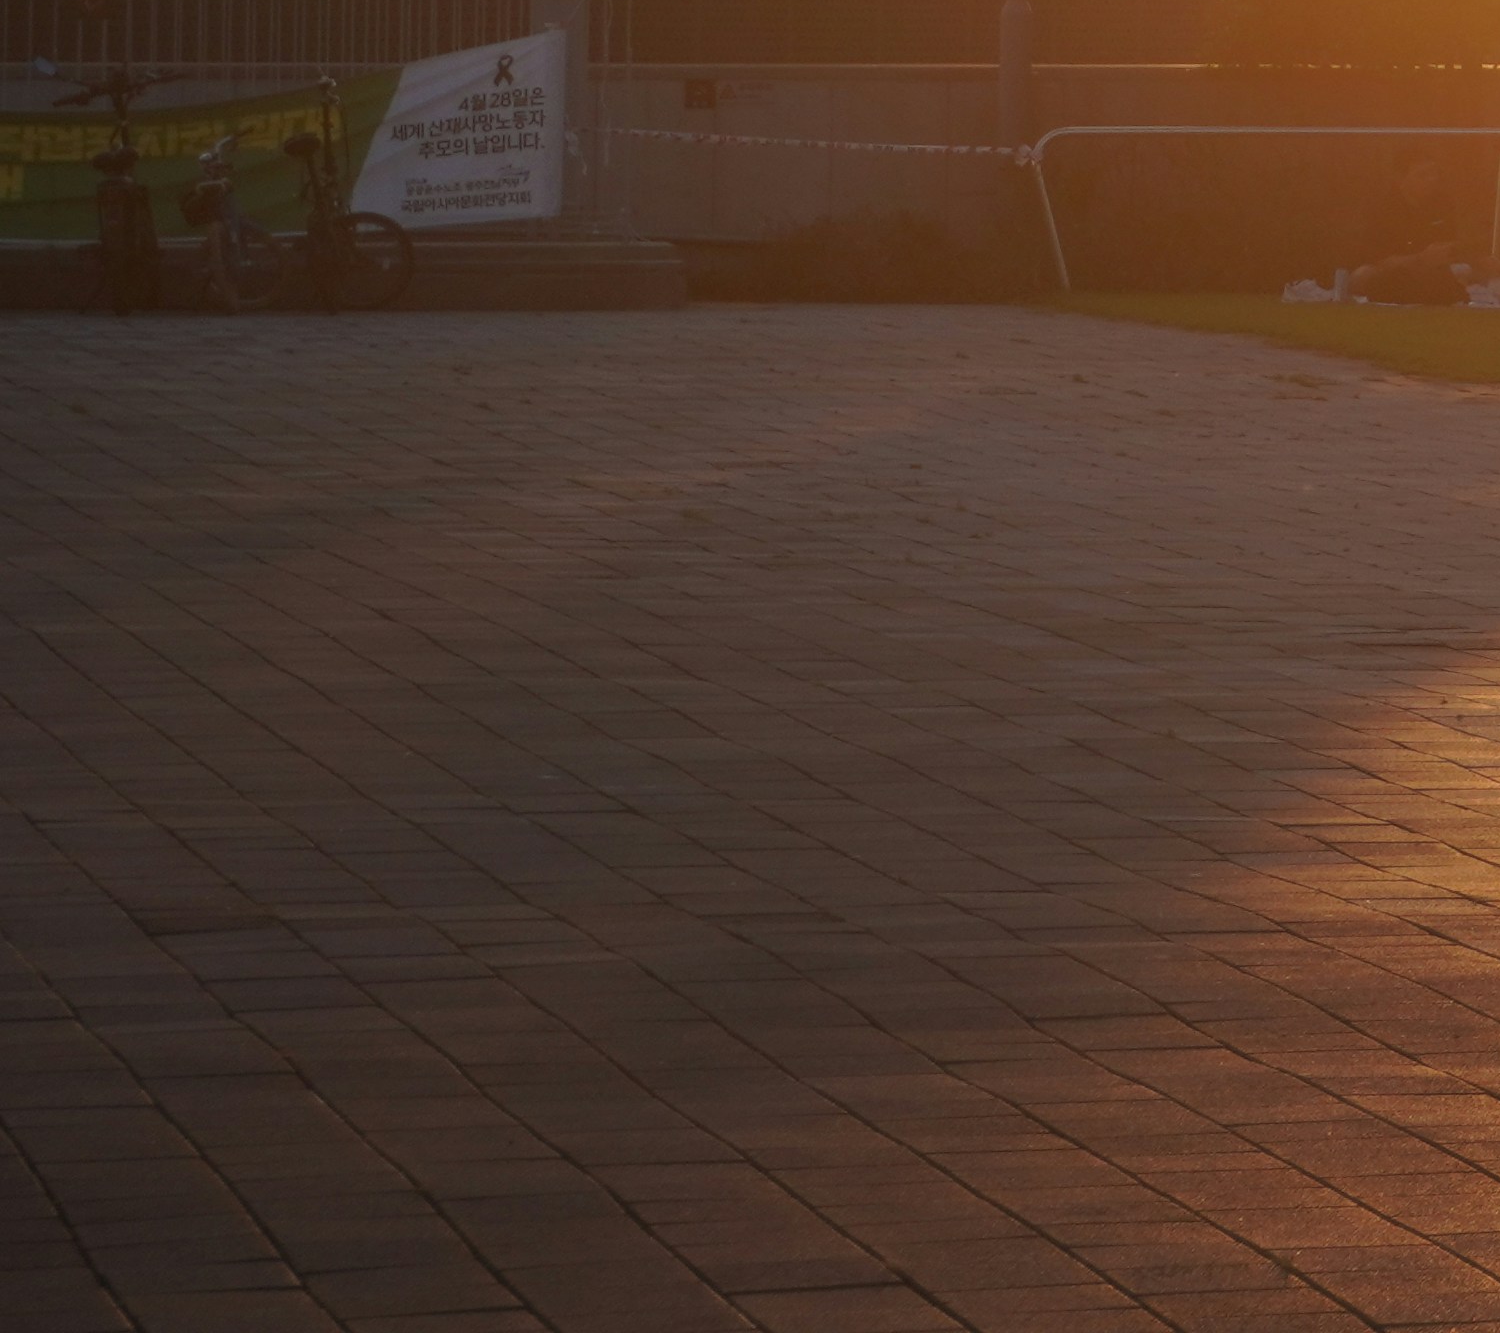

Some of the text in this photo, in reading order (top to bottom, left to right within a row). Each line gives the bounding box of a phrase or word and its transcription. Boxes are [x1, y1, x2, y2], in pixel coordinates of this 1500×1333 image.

[459, 87, 545, 111] 4월 28일은
[391, 123, 424, 141] 세계
[420, 132, 545, 159] 추모의 날입니다.
